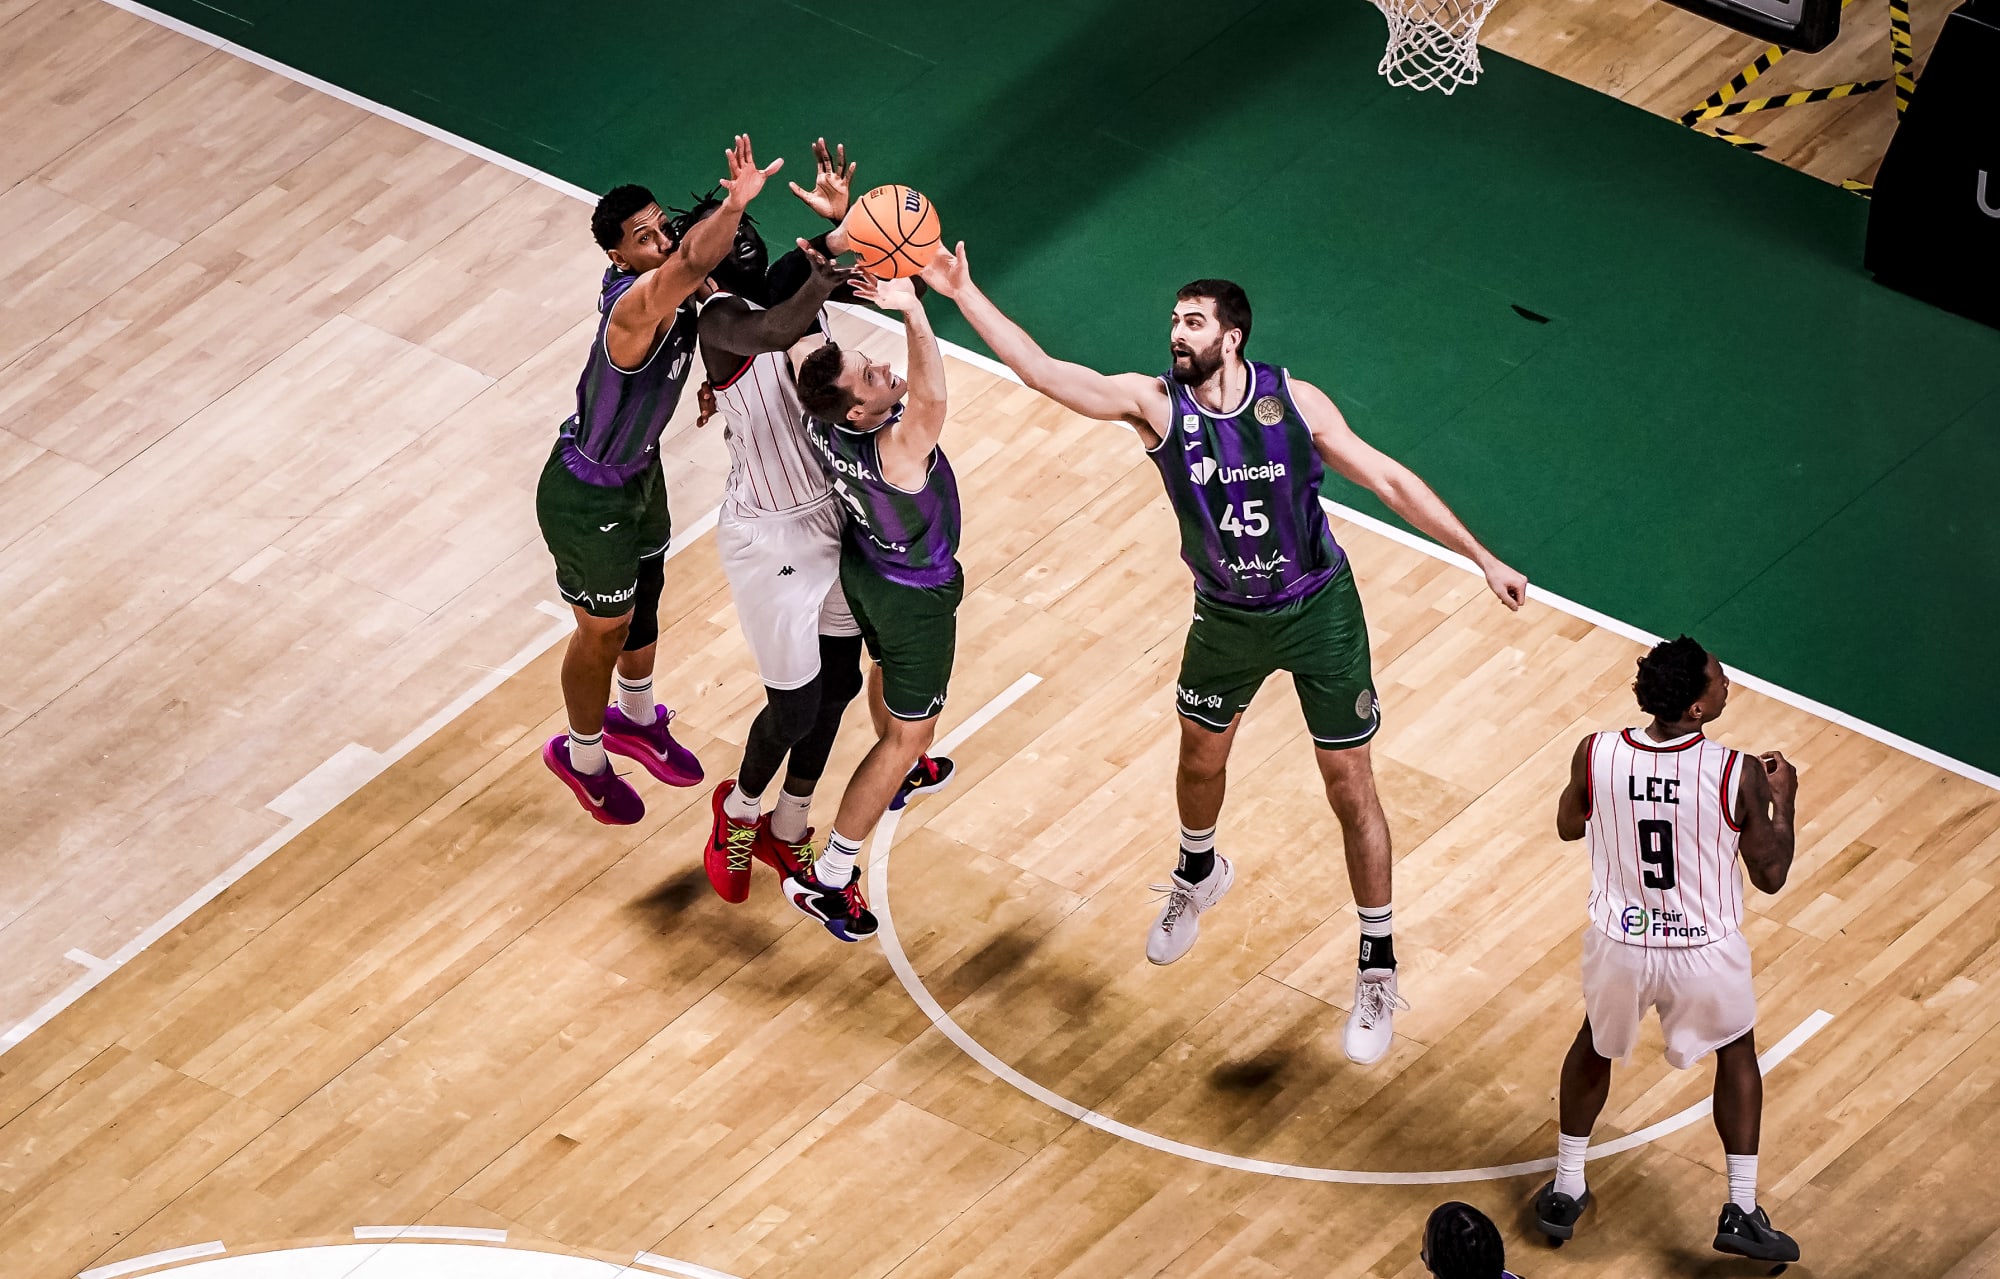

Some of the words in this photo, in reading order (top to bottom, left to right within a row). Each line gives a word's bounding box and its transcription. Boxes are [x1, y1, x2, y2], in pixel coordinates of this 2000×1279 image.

[1218, 460, 1286, 484] Unicaja
[1219, 499, 1270, 538] 45
[1628, 775, 1680, 805] LEE
[1637, 818, 1676, 890] 9
[1651, 908, 1683, 922] Fair
[1651, 922, 1708, 938] Finans
